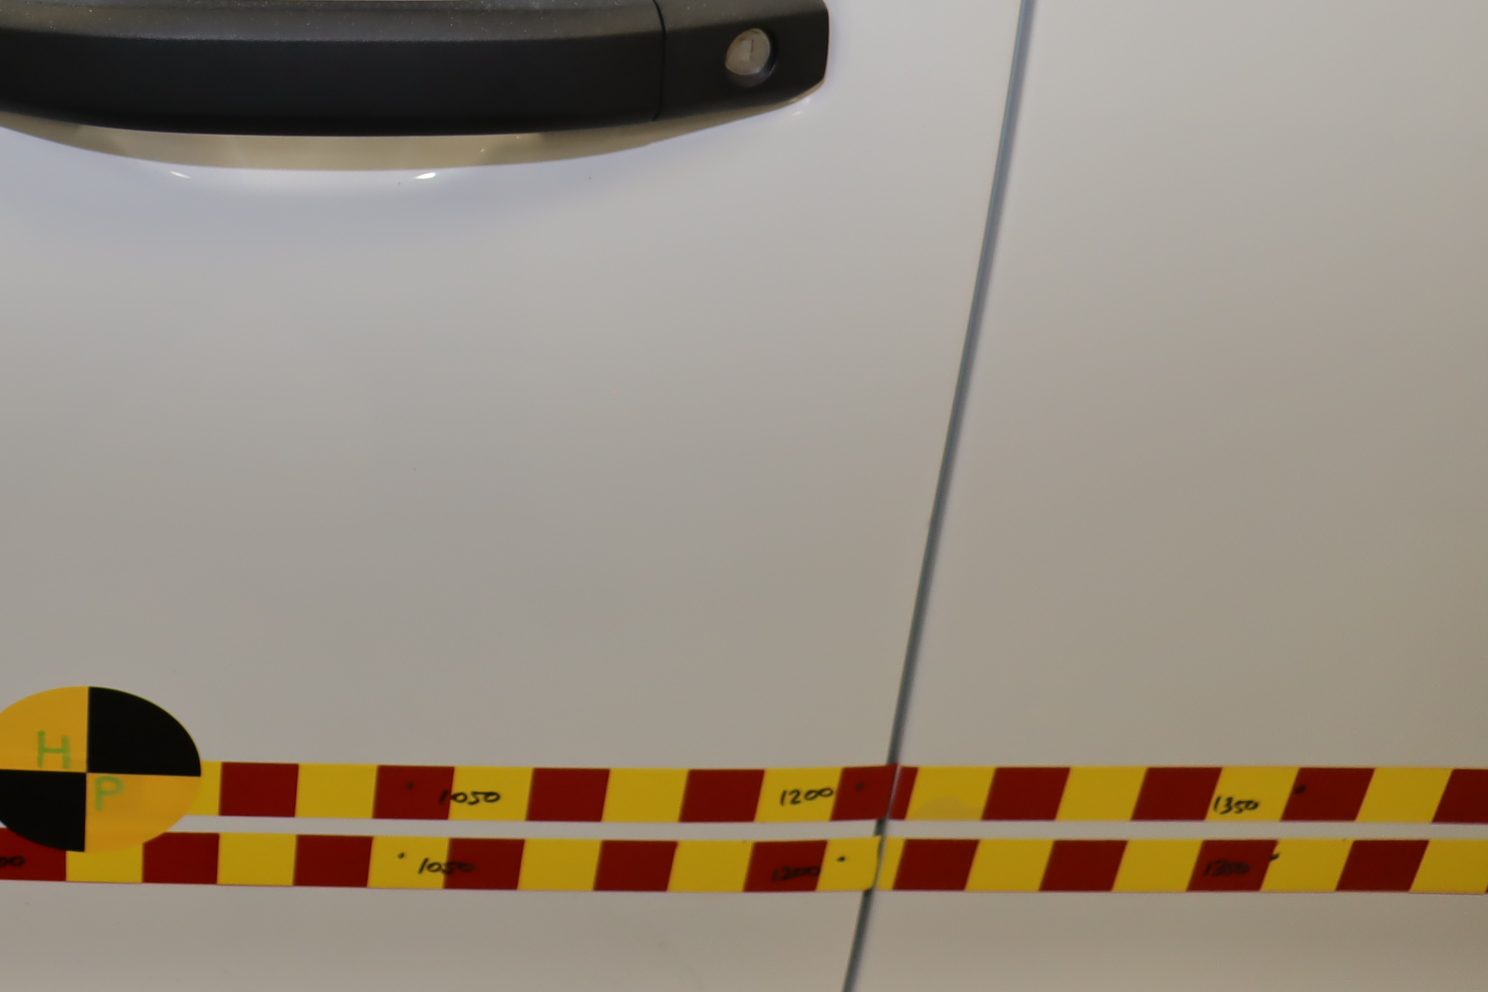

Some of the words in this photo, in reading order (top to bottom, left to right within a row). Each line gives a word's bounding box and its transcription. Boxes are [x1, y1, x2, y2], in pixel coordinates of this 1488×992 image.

[37, 730, 71, 770] H
[93, 775, 124, 811] P
[438, 789, 502, 806] 1050
[779, 786, 835, 808] 1200
[1212, 797, 1259, 814] 1350
